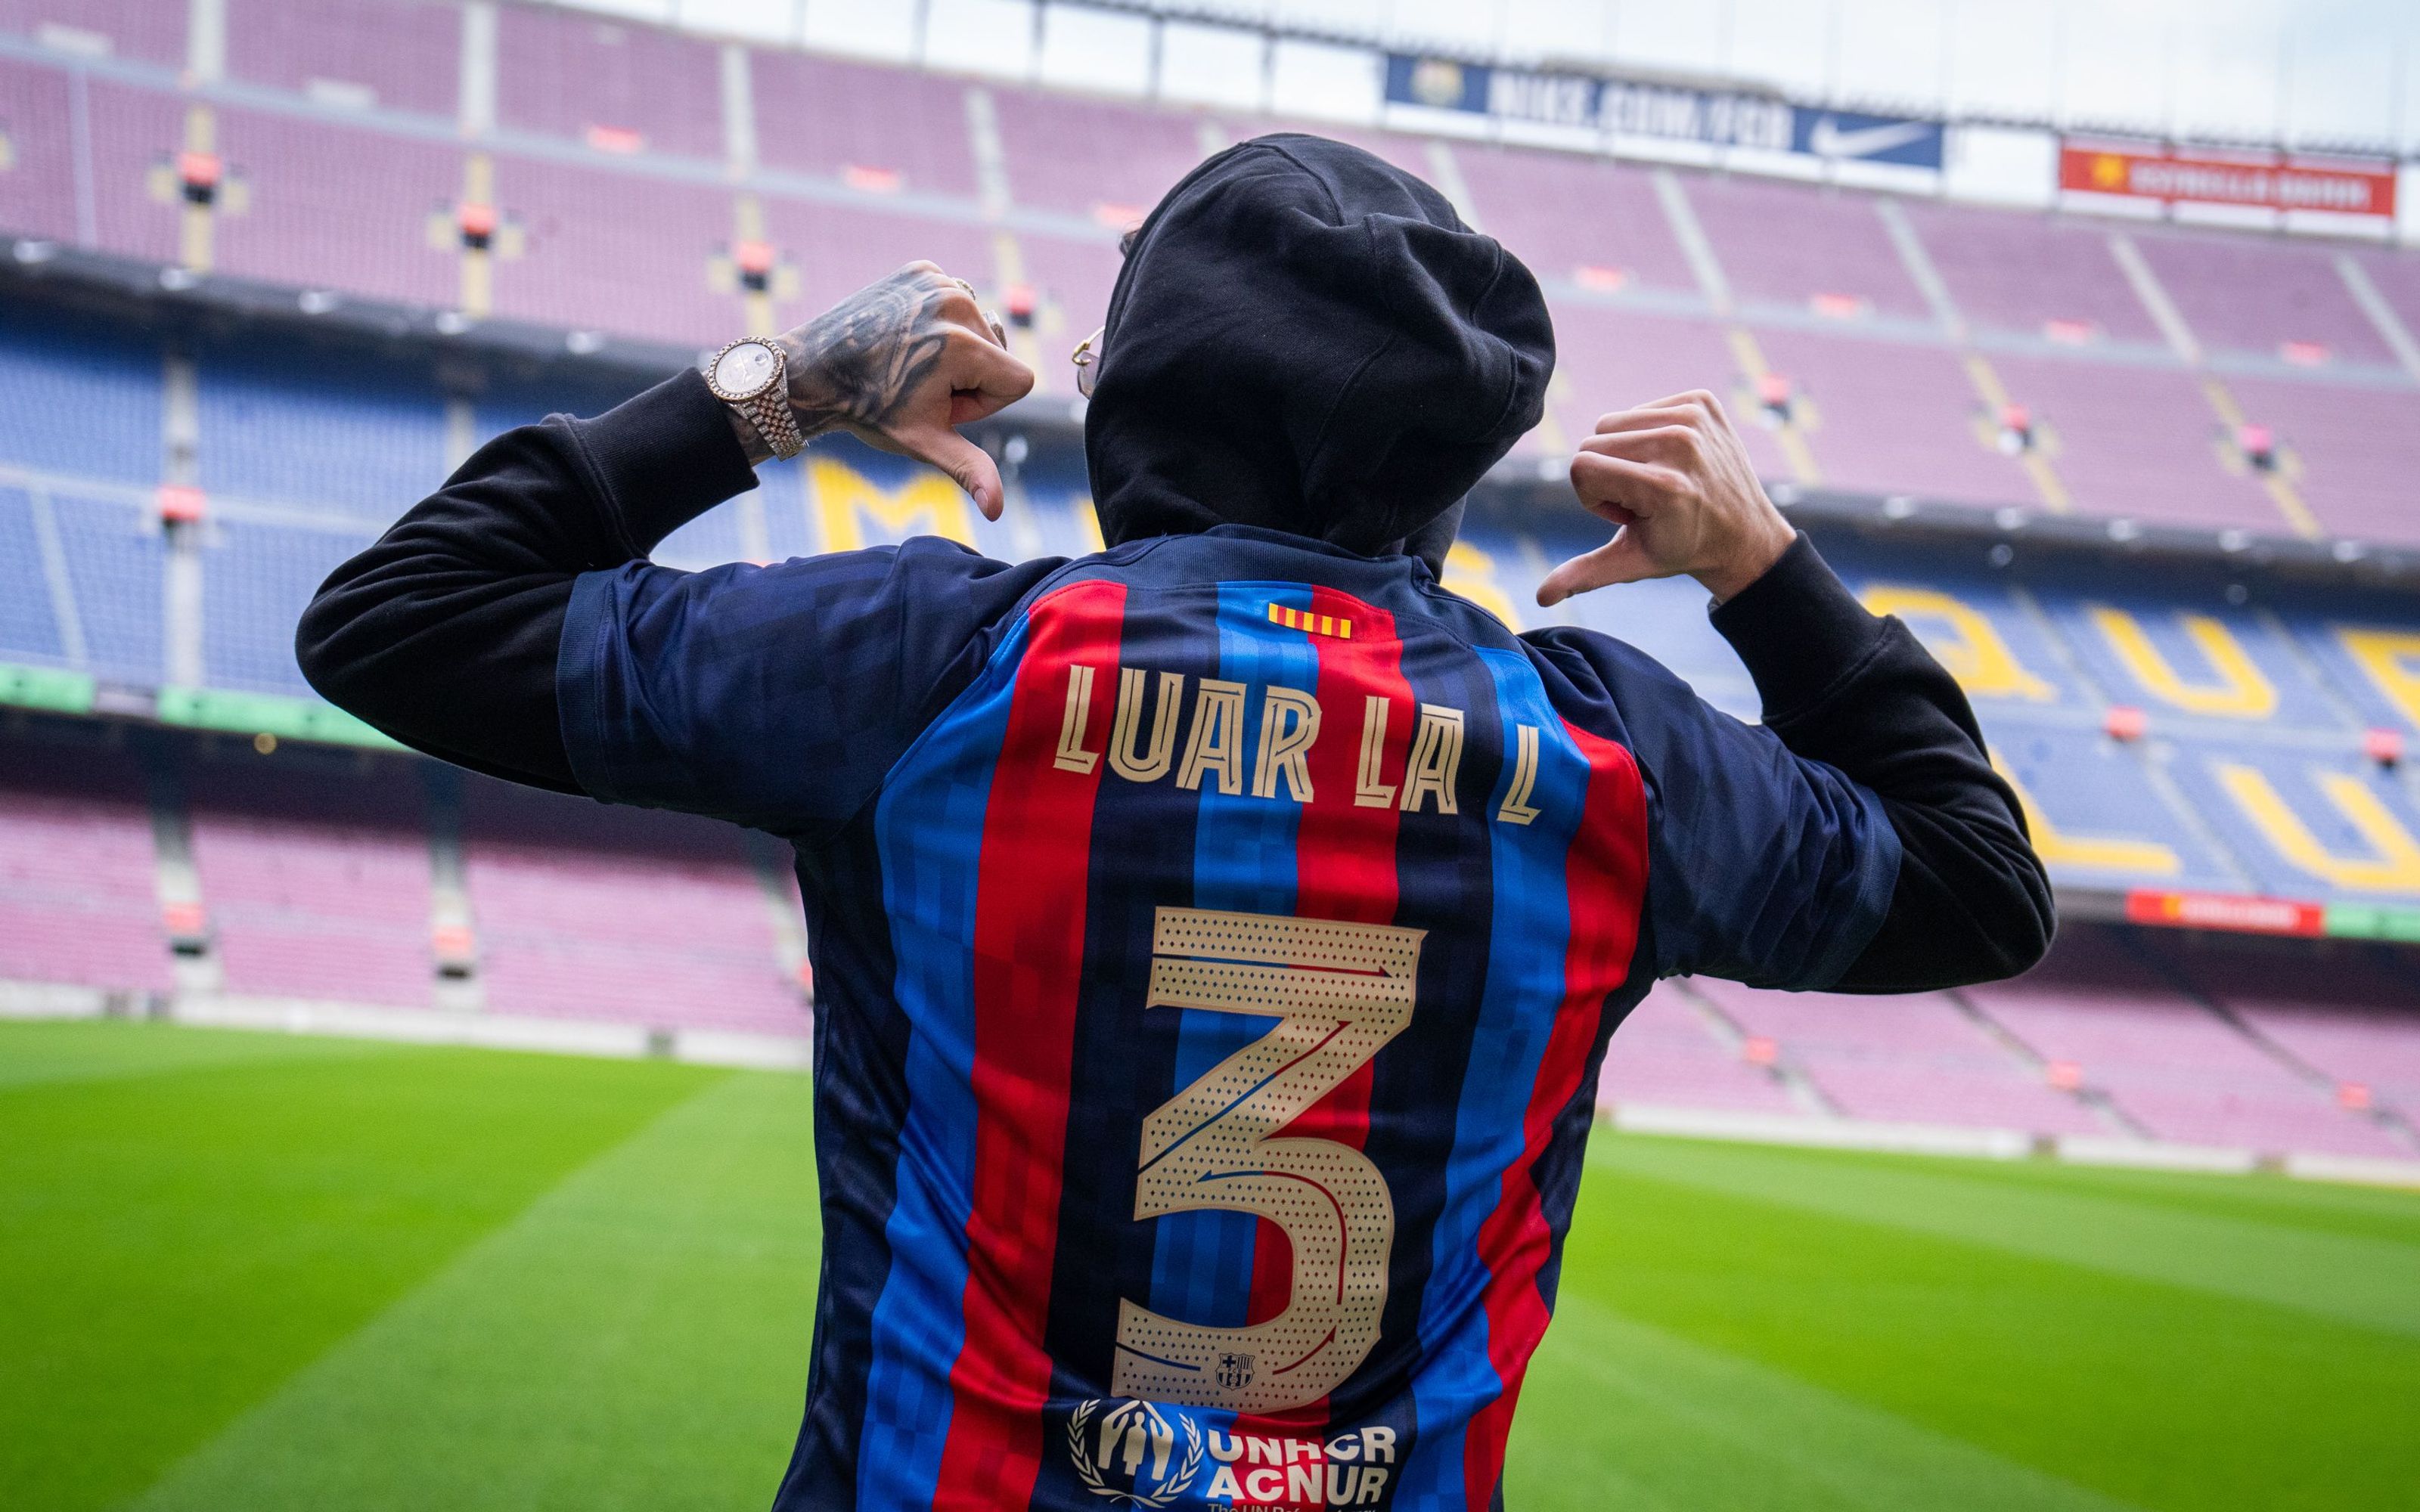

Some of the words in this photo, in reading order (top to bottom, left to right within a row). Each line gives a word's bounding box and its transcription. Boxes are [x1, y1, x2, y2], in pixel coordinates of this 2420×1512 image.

[1053, 664, 1322, 803] LUAR
[1354, 696, 1464, 814] LA
[1497, 724, 1541, 826] L
[1111, 906, 1429, 1413] 3
[1206, 1464, 1388, 1504] ACNUR
[1208, 1426, 1396, 1466] UNHCR
